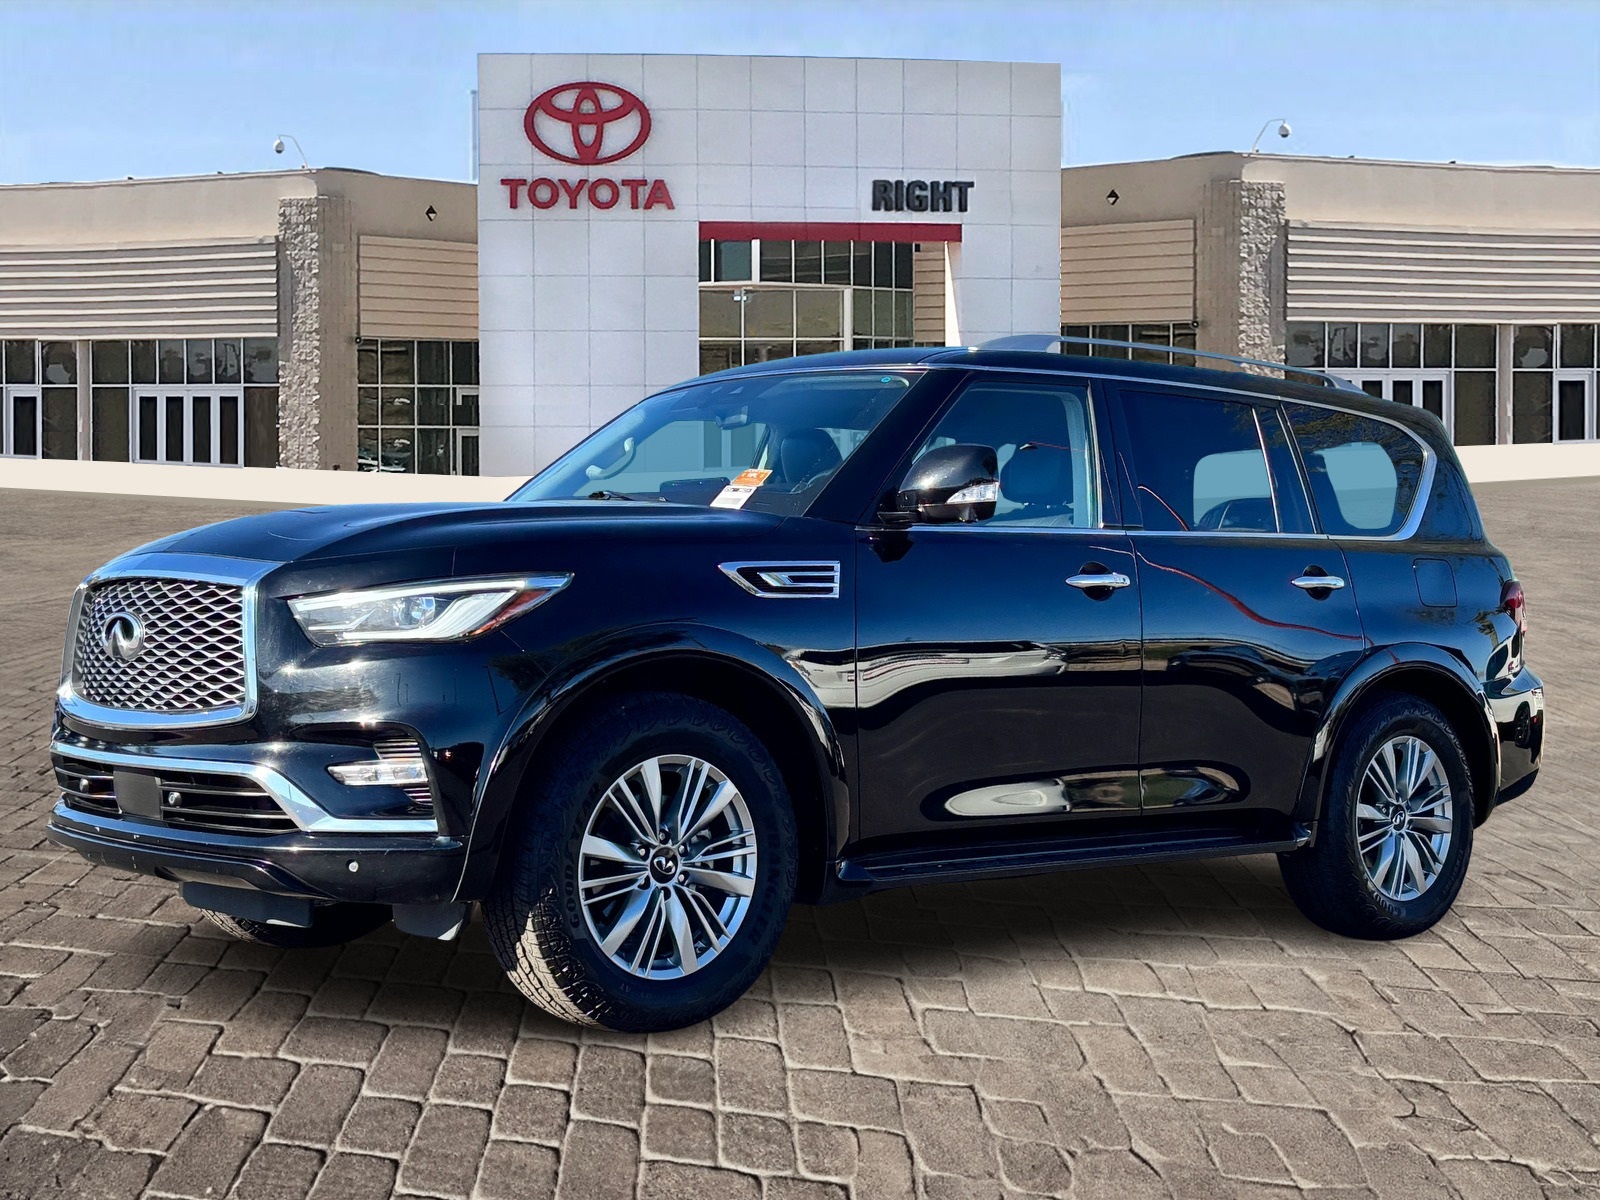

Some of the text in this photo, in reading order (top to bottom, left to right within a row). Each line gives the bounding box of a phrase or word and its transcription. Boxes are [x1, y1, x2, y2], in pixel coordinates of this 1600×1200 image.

[500, 178, 675, 210] TOYOTA
[872, 180, 975, 212] RIGHT
[564, 782, 600, 929] GOODYEAR
